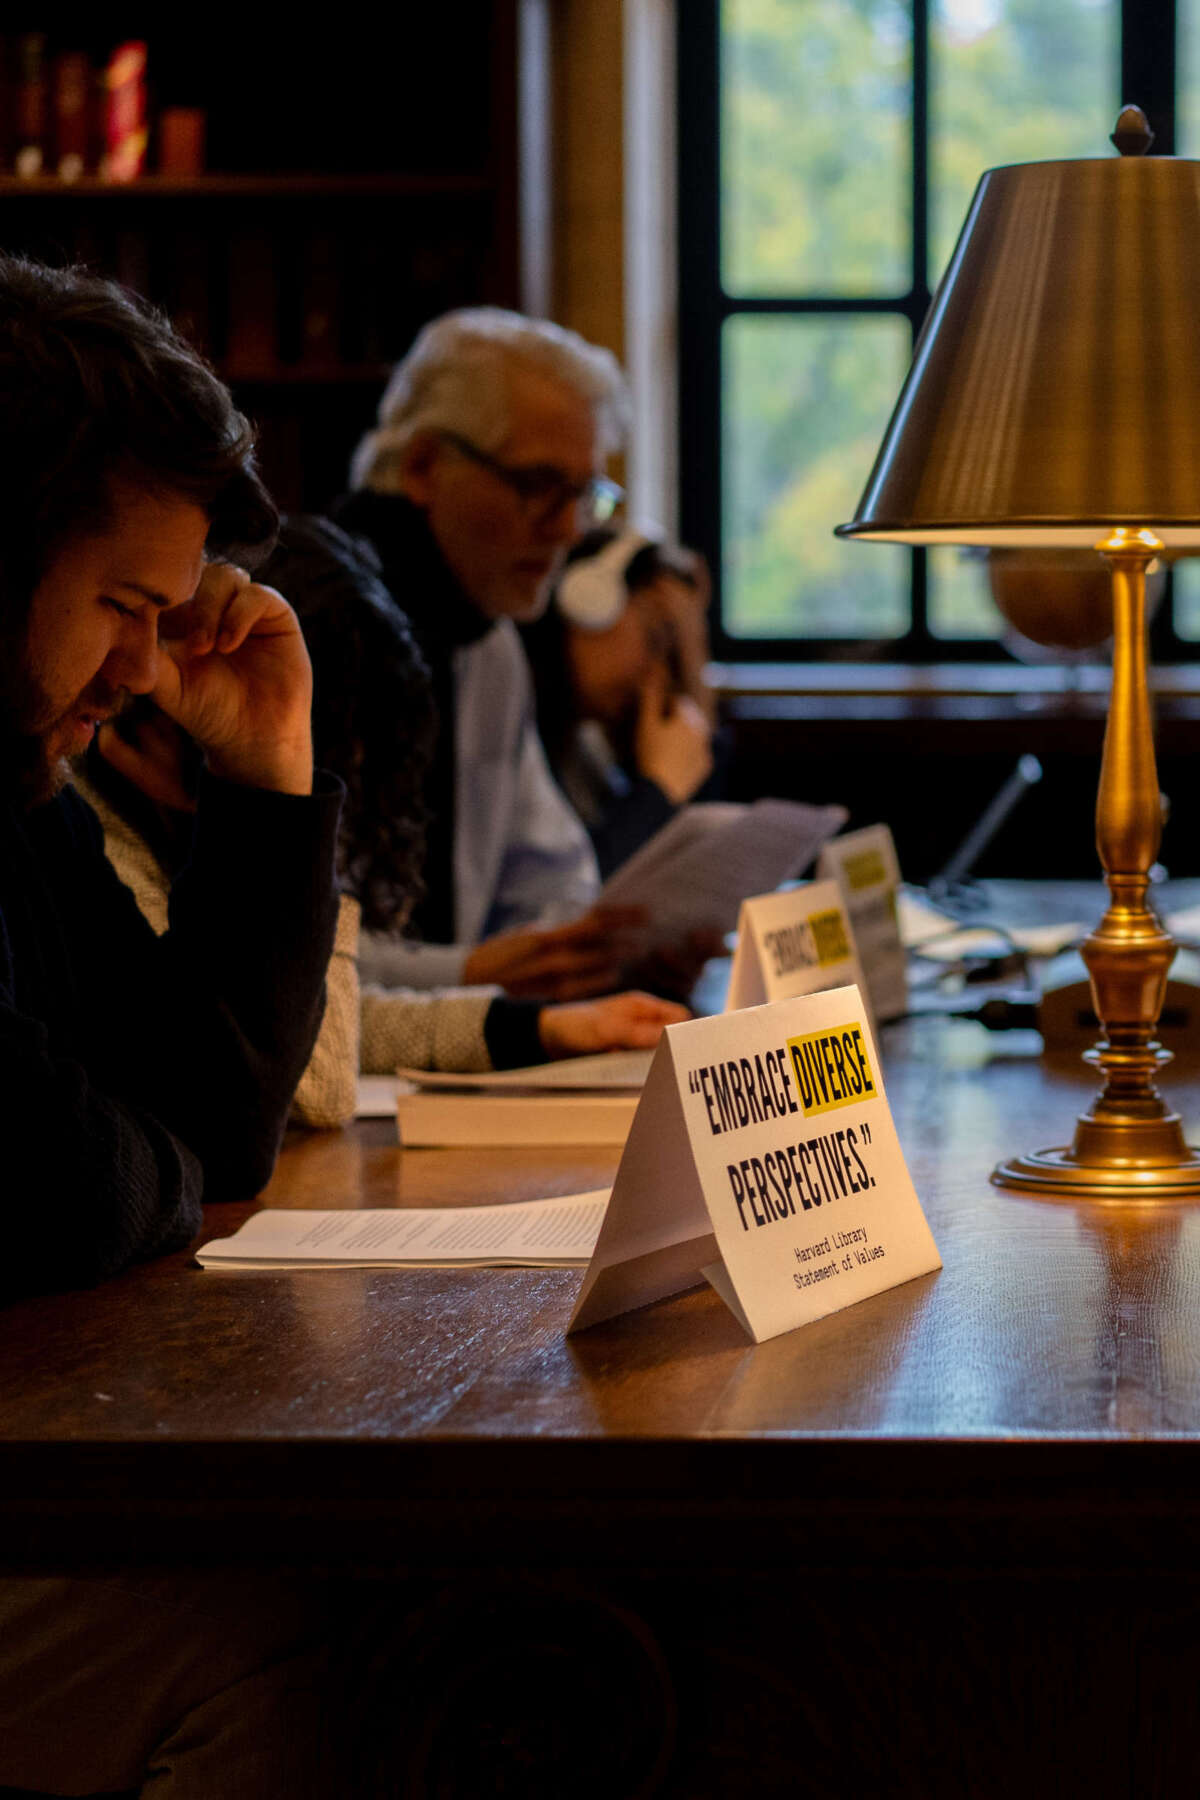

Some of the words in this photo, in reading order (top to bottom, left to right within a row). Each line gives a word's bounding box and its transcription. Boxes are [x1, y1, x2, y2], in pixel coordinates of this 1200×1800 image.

[689, 1049, 798, 1135] “EMBRACE
[791, 1031, 873, 1109] DIVERSE
[794, 1237, 831, 1263] Harvard
[832, 1227, 868, 1249] Library
[793, 1260, 839, 1289] Statement
[842, 1254, 853, 1271] of
[853, 1246, 885, 1264] Values
